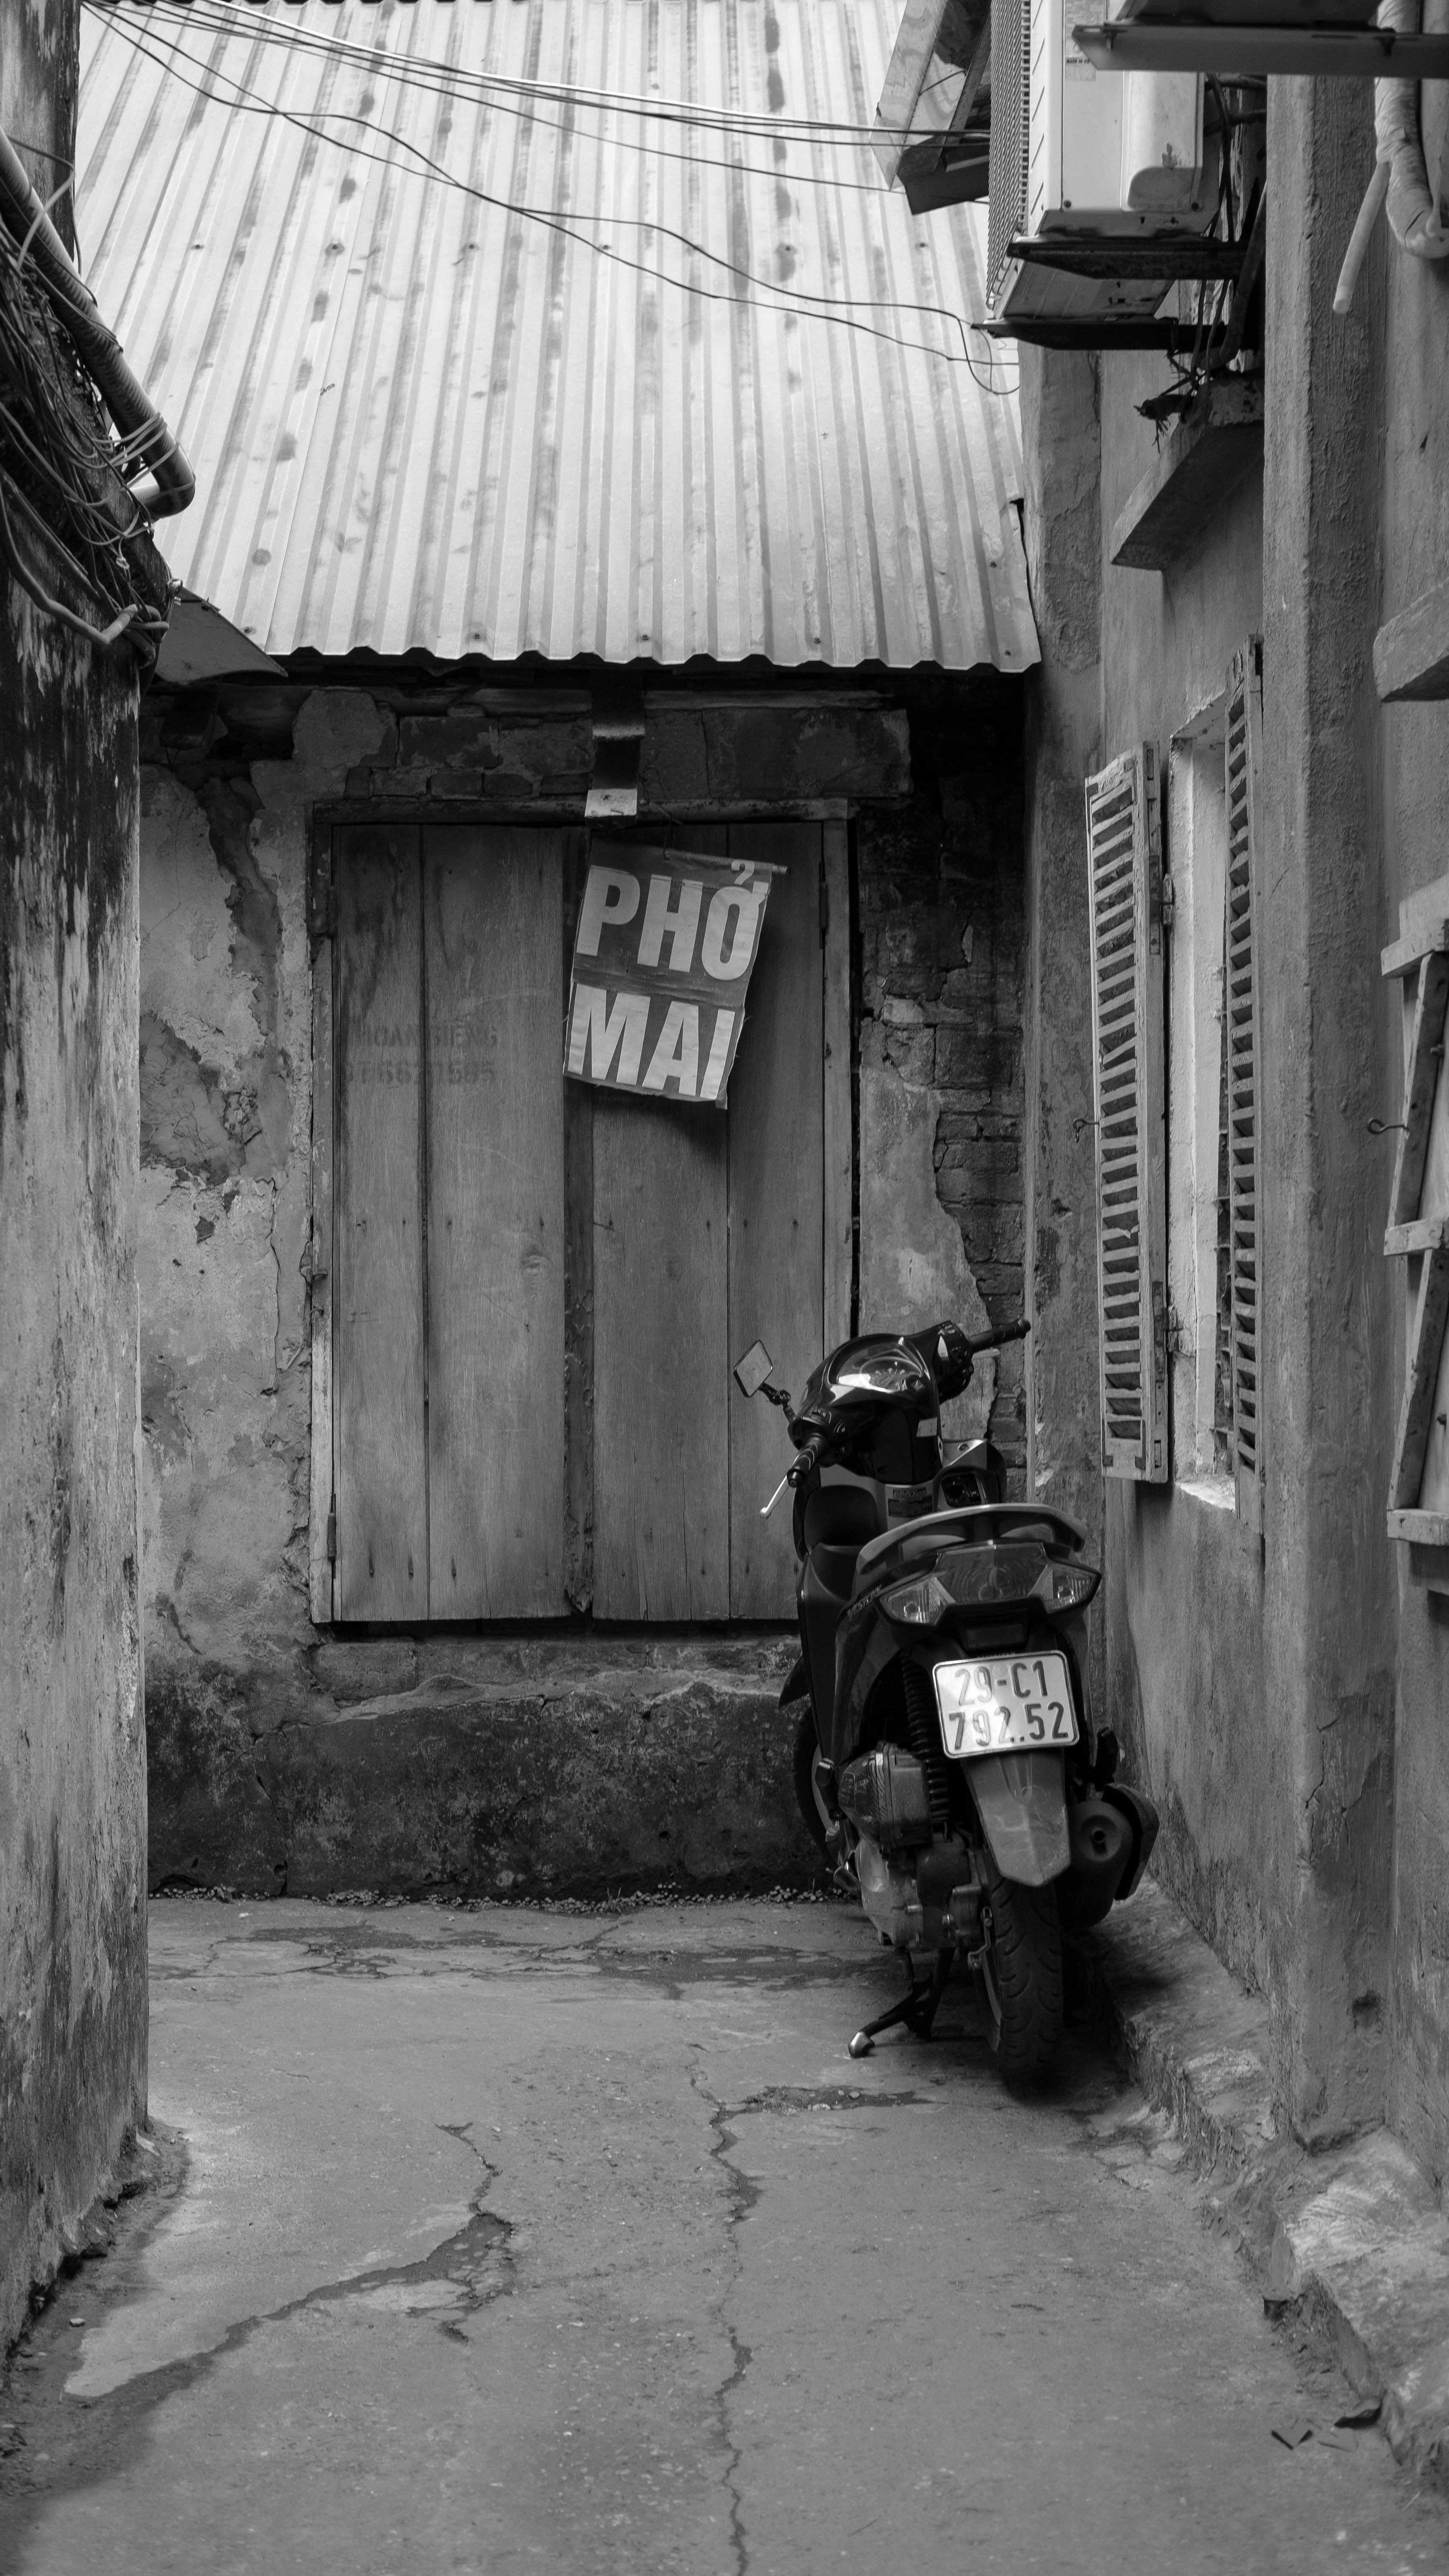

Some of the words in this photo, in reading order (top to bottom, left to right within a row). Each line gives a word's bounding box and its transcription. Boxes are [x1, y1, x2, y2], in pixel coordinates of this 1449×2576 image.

[576, 859, 769, 981] PHỞ
[567, 982, 736, 1100] MAI
[955, 1660, 1048, 1707] 29-C1
[948, 1702, 1069, 1750] 792.52
